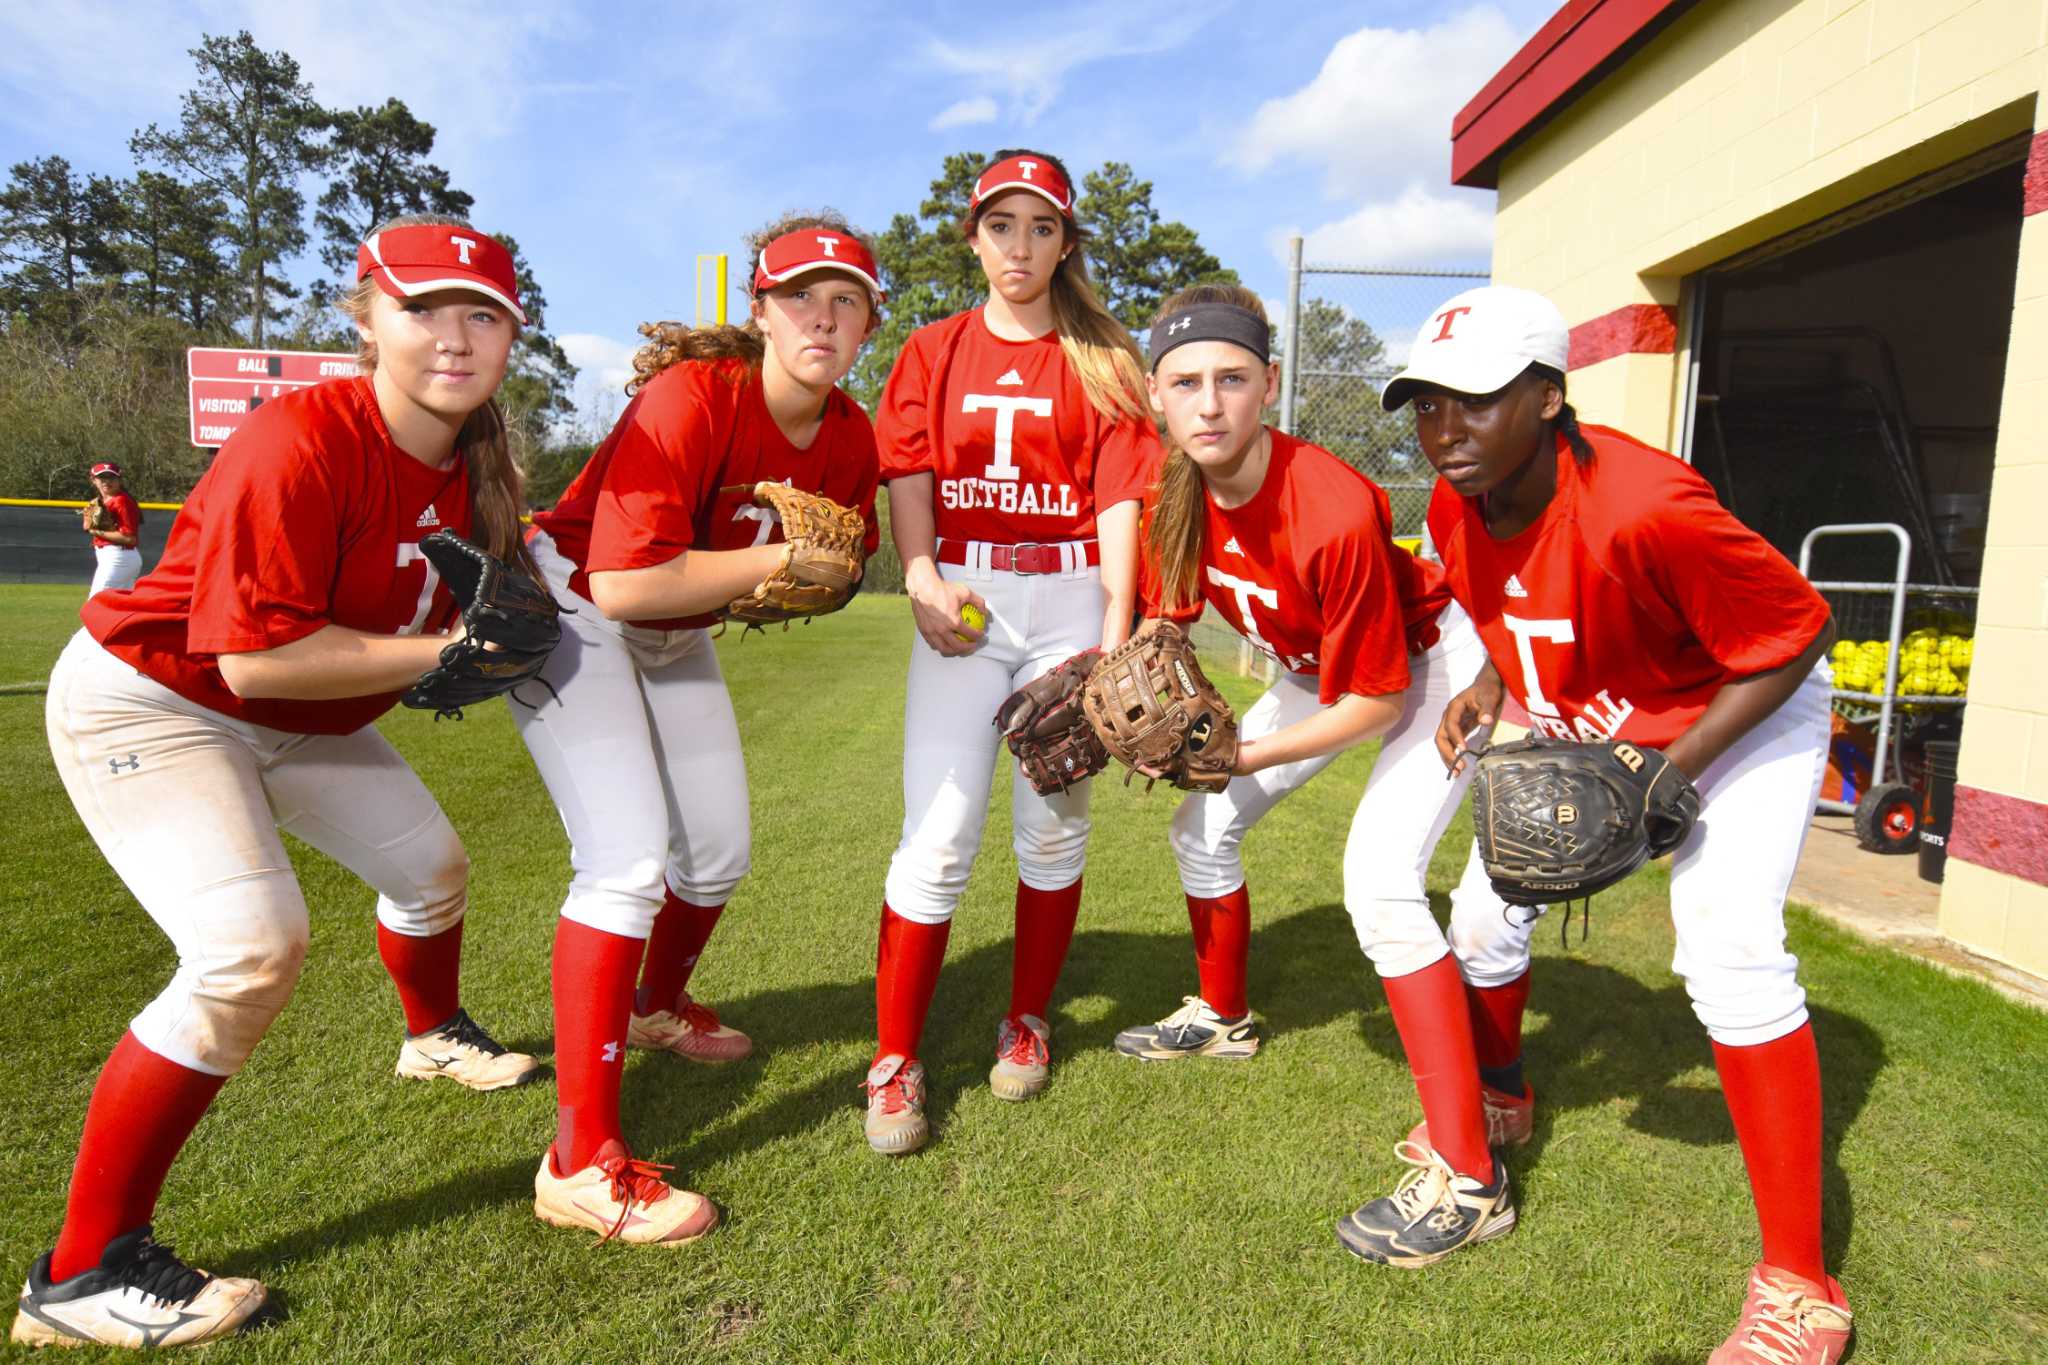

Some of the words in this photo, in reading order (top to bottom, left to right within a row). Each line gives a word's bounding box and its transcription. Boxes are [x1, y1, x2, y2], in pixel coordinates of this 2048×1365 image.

[1019, 162, 1037, 179] T
[450, 235, 476, 265] T
[816, 236, 840, 257] T
[1432, 306, 1471, 343] T
[238, 358, 268, 373] BALL
[253, 384, 260, 397] 1
[271, 385, 280, 398] 2
[199, 398, 246, 414] VISITOR
[199, 425, 237, 441] TOMB
[962, 394, 1053, 480] T
[1206, 565, 1278, 653] T
[1502, 612, 1575, 718] T
